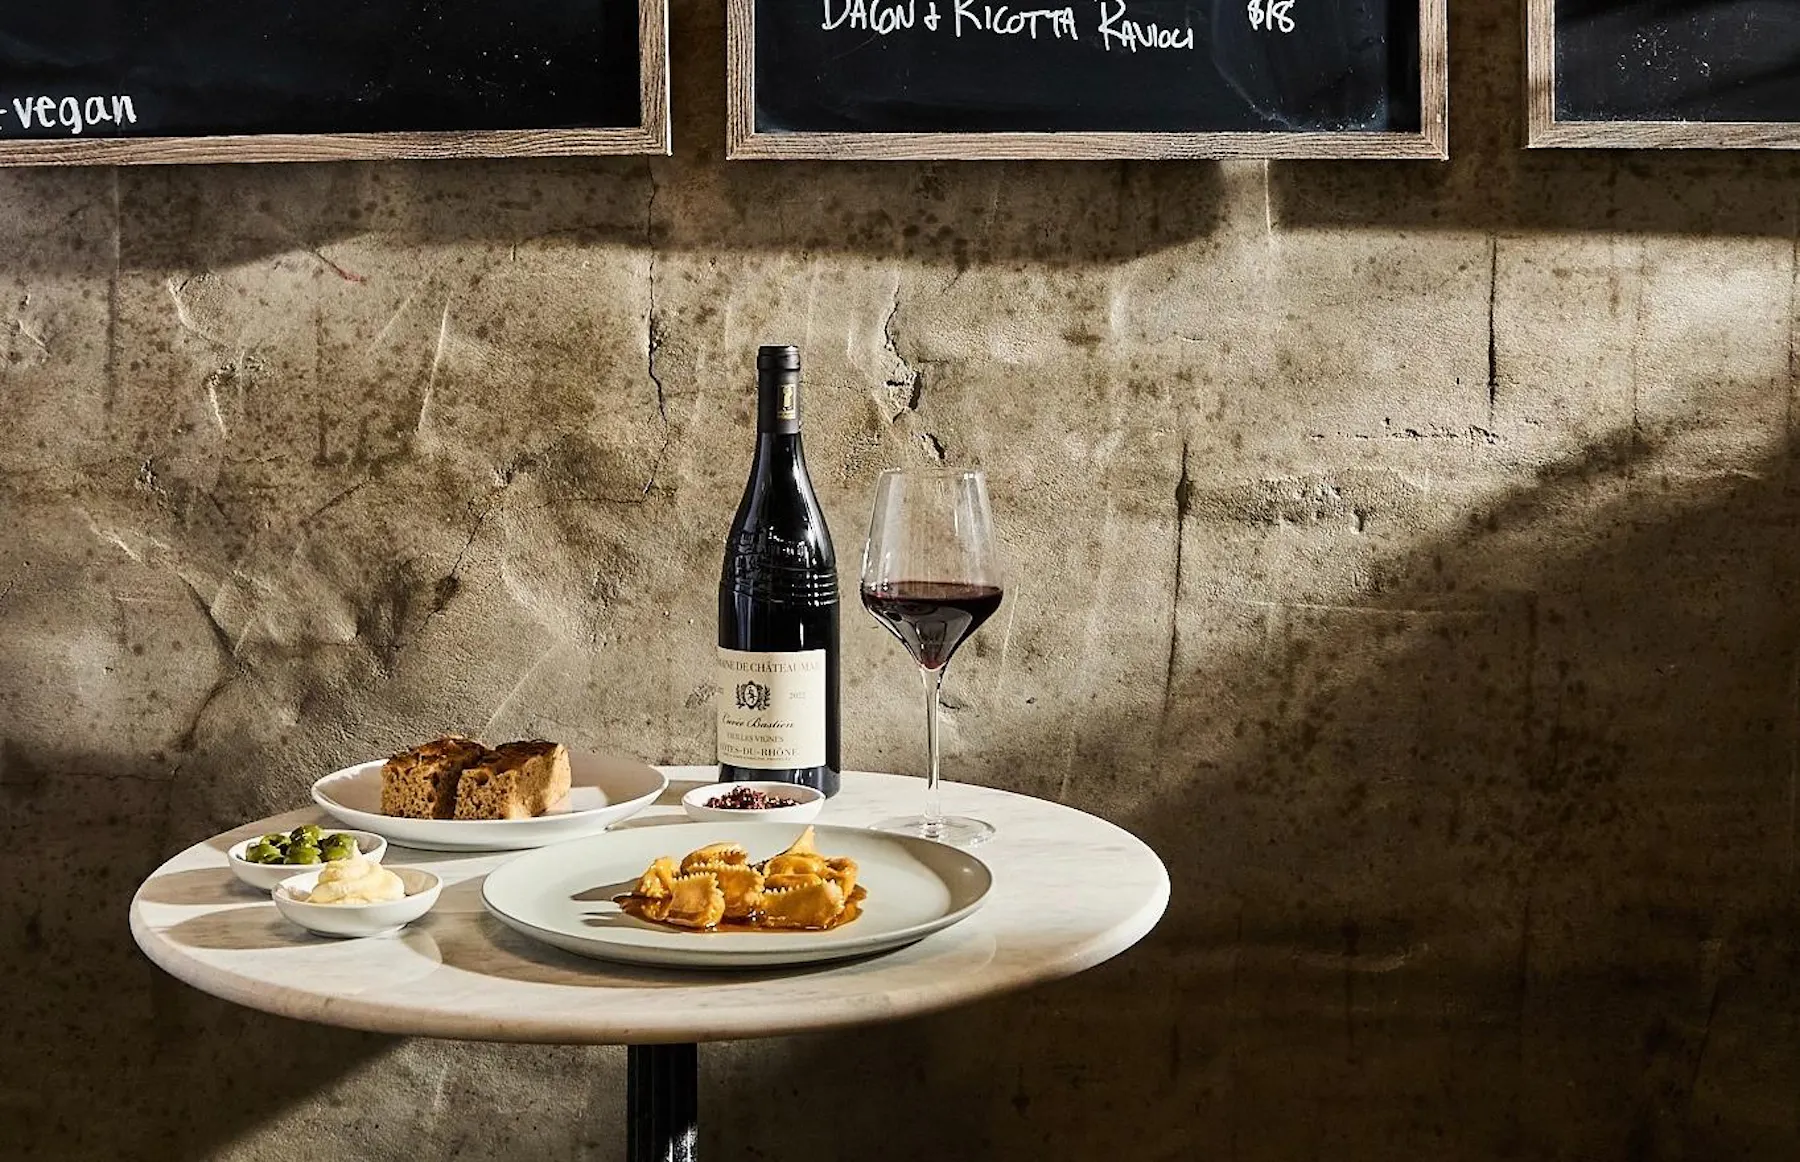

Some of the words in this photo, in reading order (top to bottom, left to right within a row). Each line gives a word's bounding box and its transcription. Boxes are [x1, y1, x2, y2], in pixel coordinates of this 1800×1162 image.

[1247, 0, 1296, 33] $18
[736, 660, 748, 671] DE
[746, 717, 794, 728] Bastien
